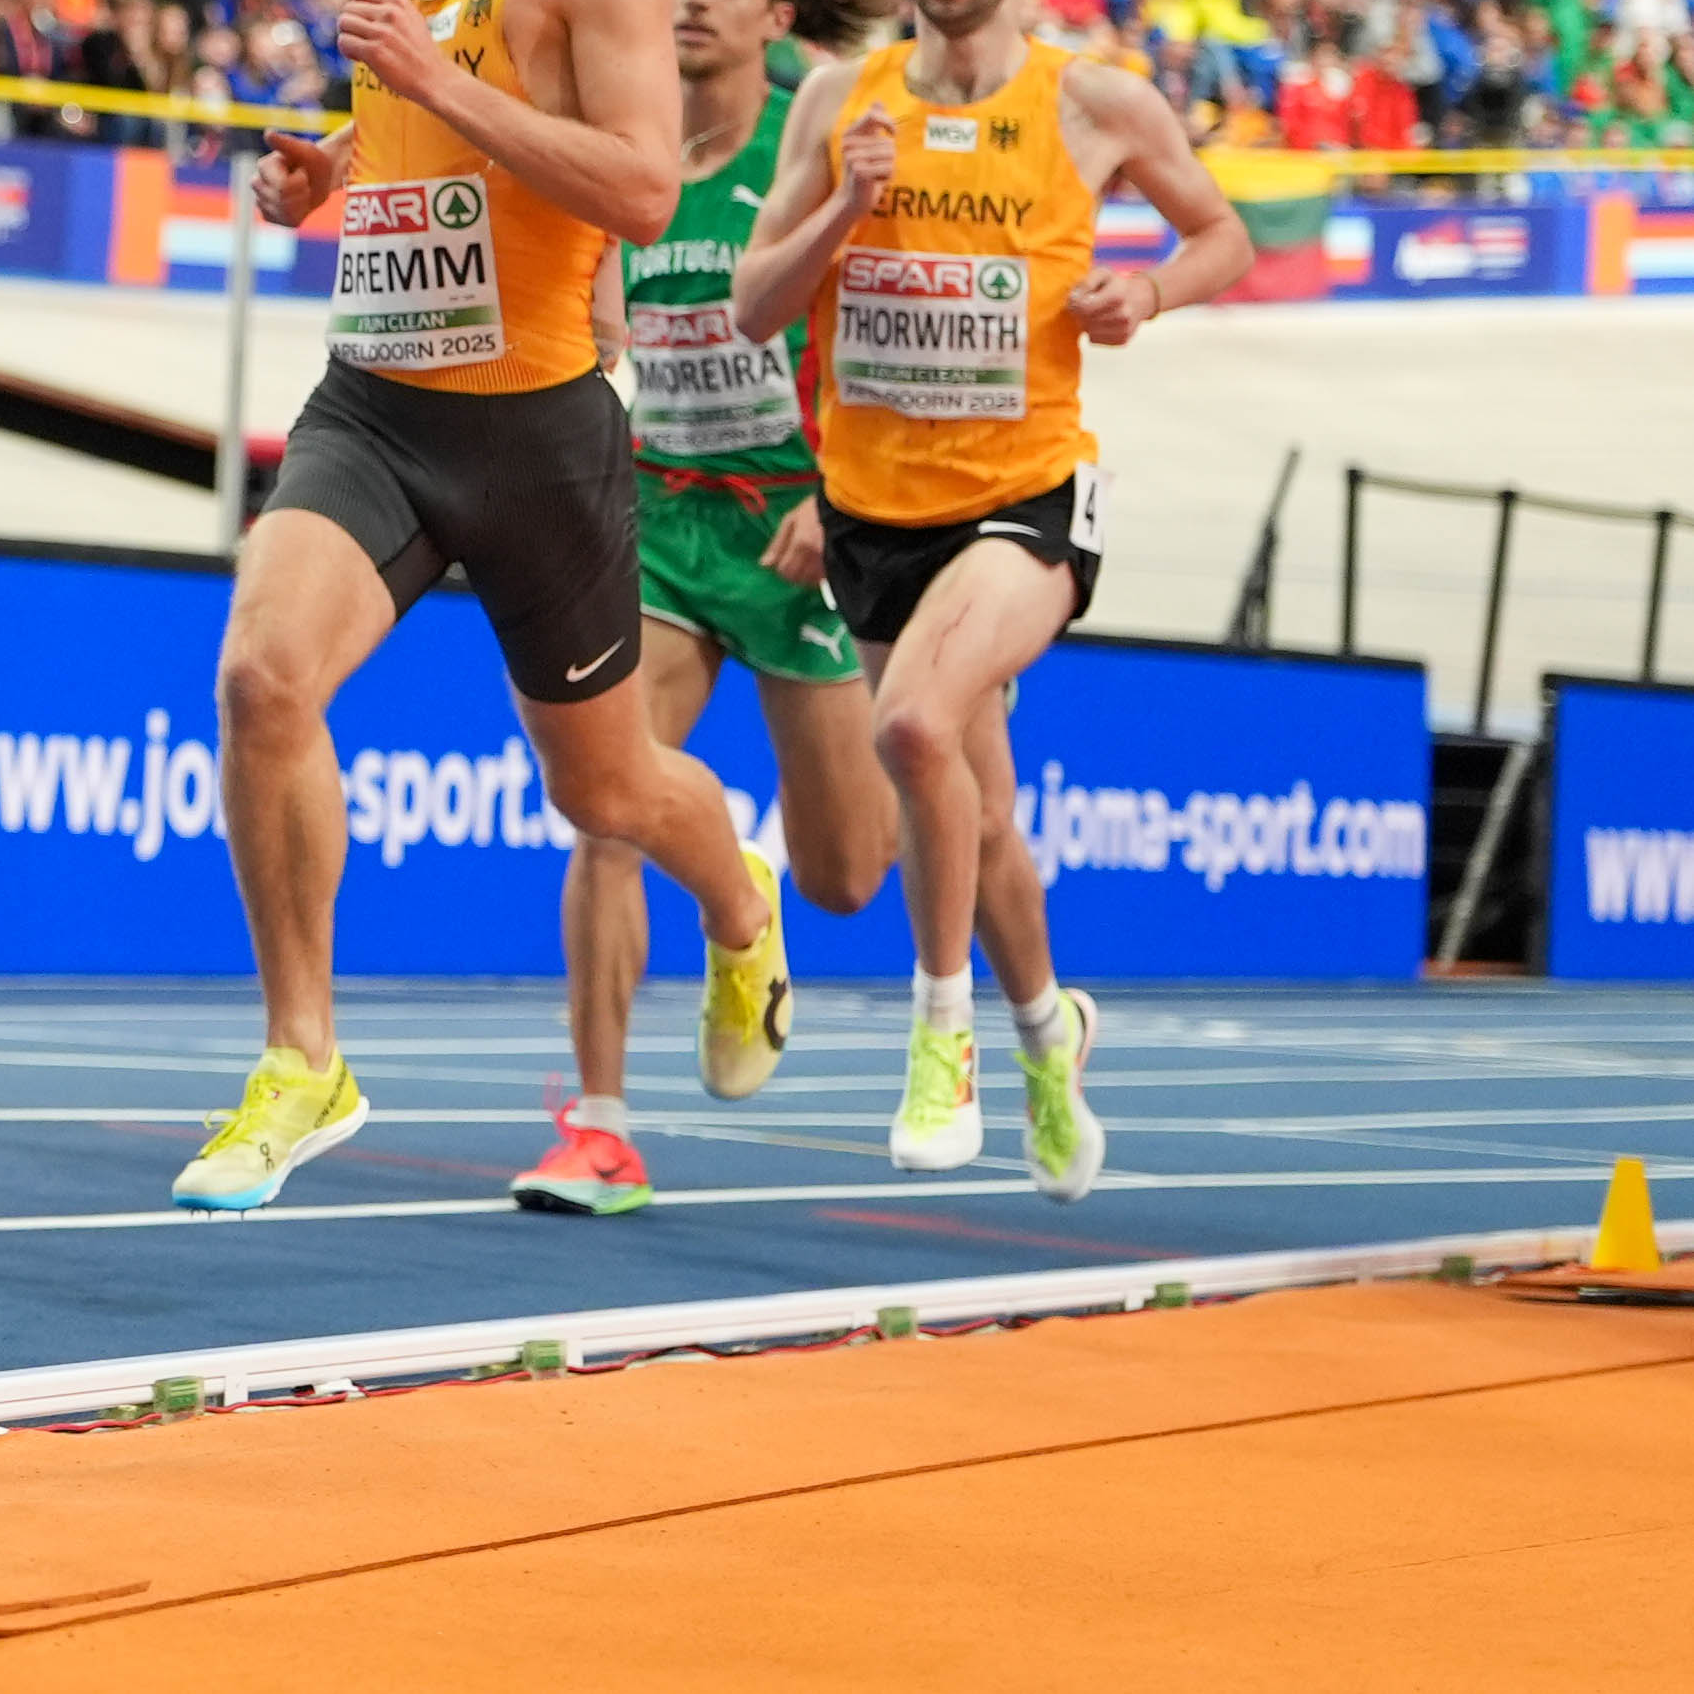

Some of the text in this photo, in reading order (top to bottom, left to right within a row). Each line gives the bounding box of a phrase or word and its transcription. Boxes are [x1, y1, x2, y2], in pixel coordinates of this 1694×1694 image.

[345, 192, 425, 232] SPAR
[872, 185, 1034, 228] ERMANY
[340, 242, 486, 294] BREMM
[845, 257, 971, 296] SPAR
[331, 333, 496, 363] APELDOORN 2025
[841, 304, 1018, 351] THORWIRTH
[636, 348, 785, 395] MOREIRA
